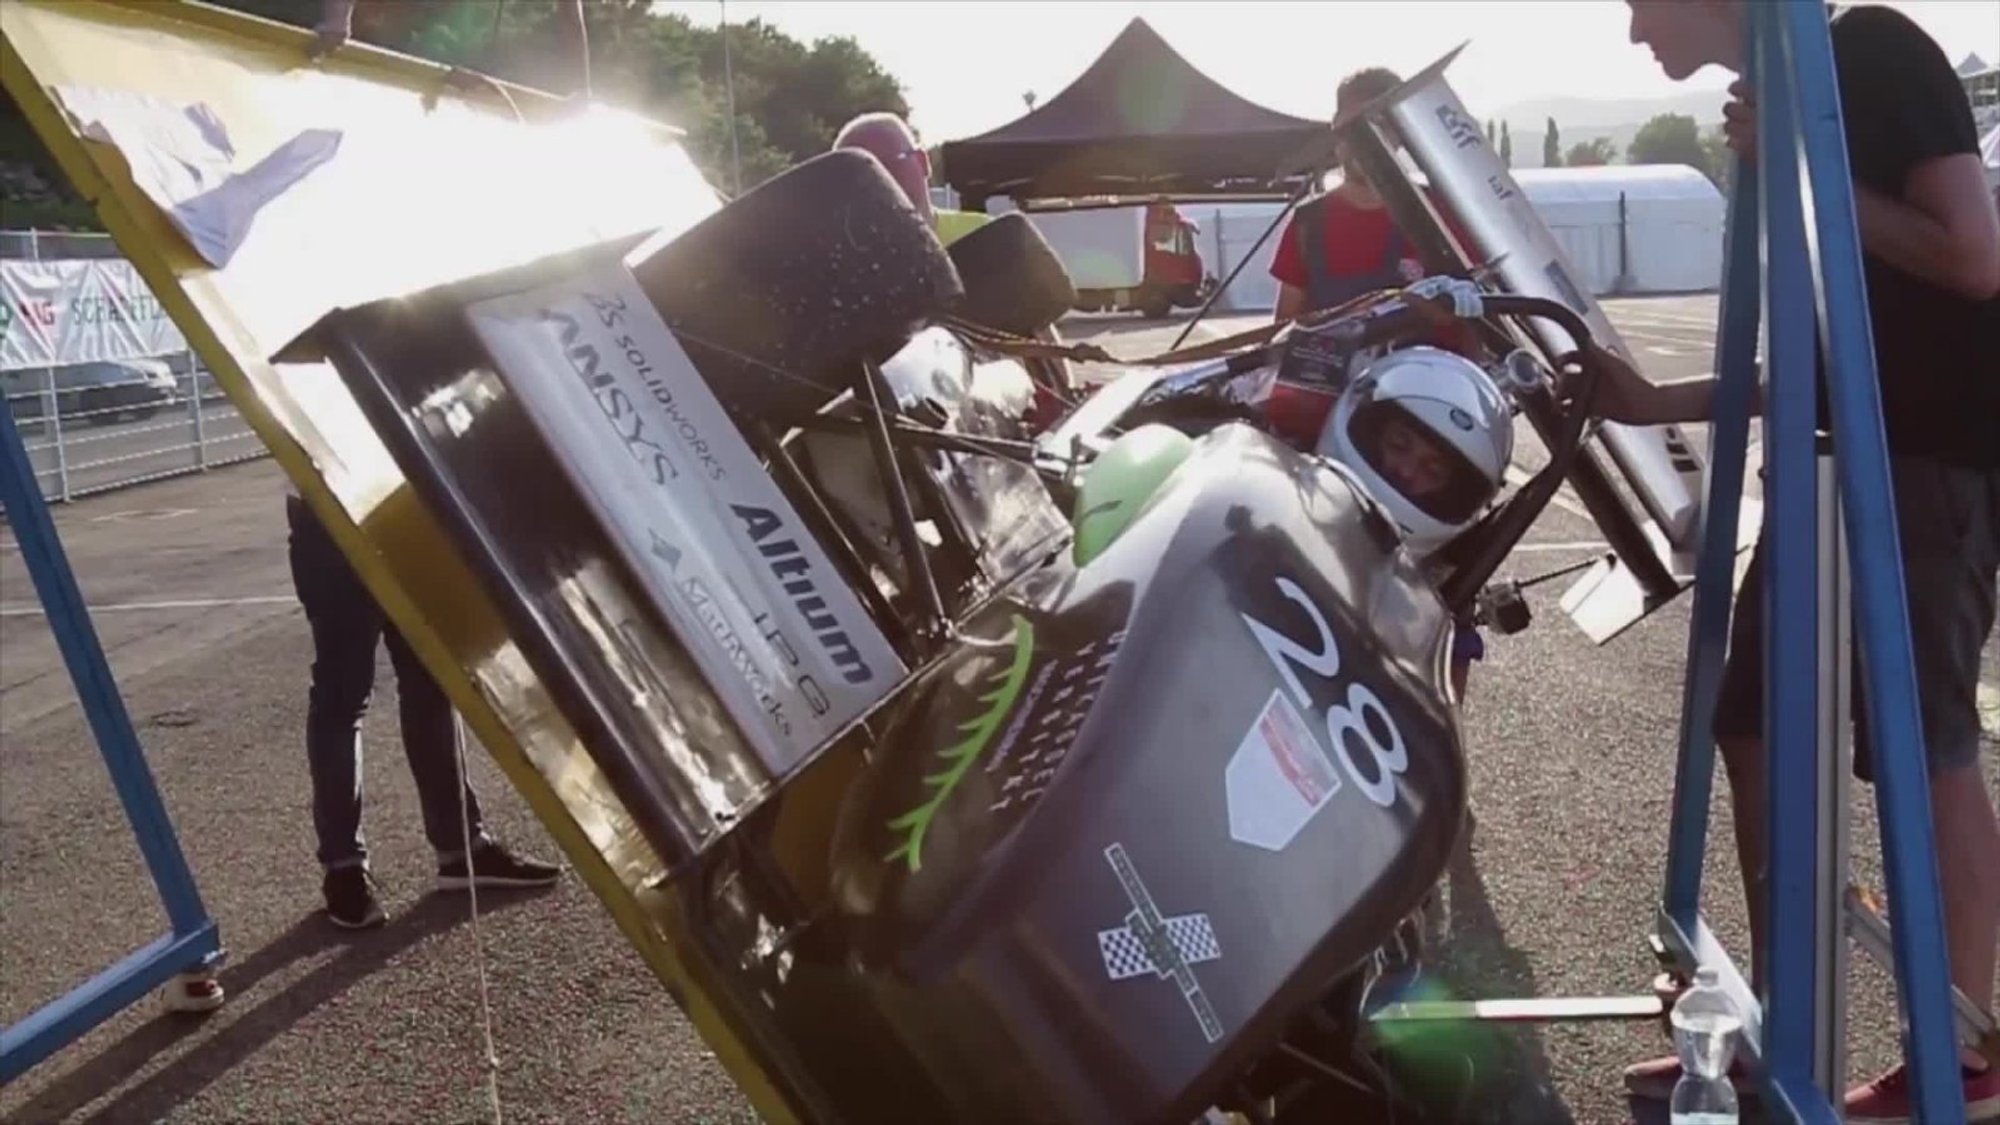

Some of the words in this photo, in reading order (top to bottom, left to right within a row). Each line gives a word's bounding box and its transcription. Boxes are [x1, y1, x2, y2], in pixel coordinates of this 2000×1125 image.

[536, 308, 680, 486] ANSYS
[614, 334, 727, 481] SOLIDWORKS
[682, 576, 793, 738] MathWorks
[729, 502, 874, 685] Altium
[1242, 576, 1409, 808] 28
